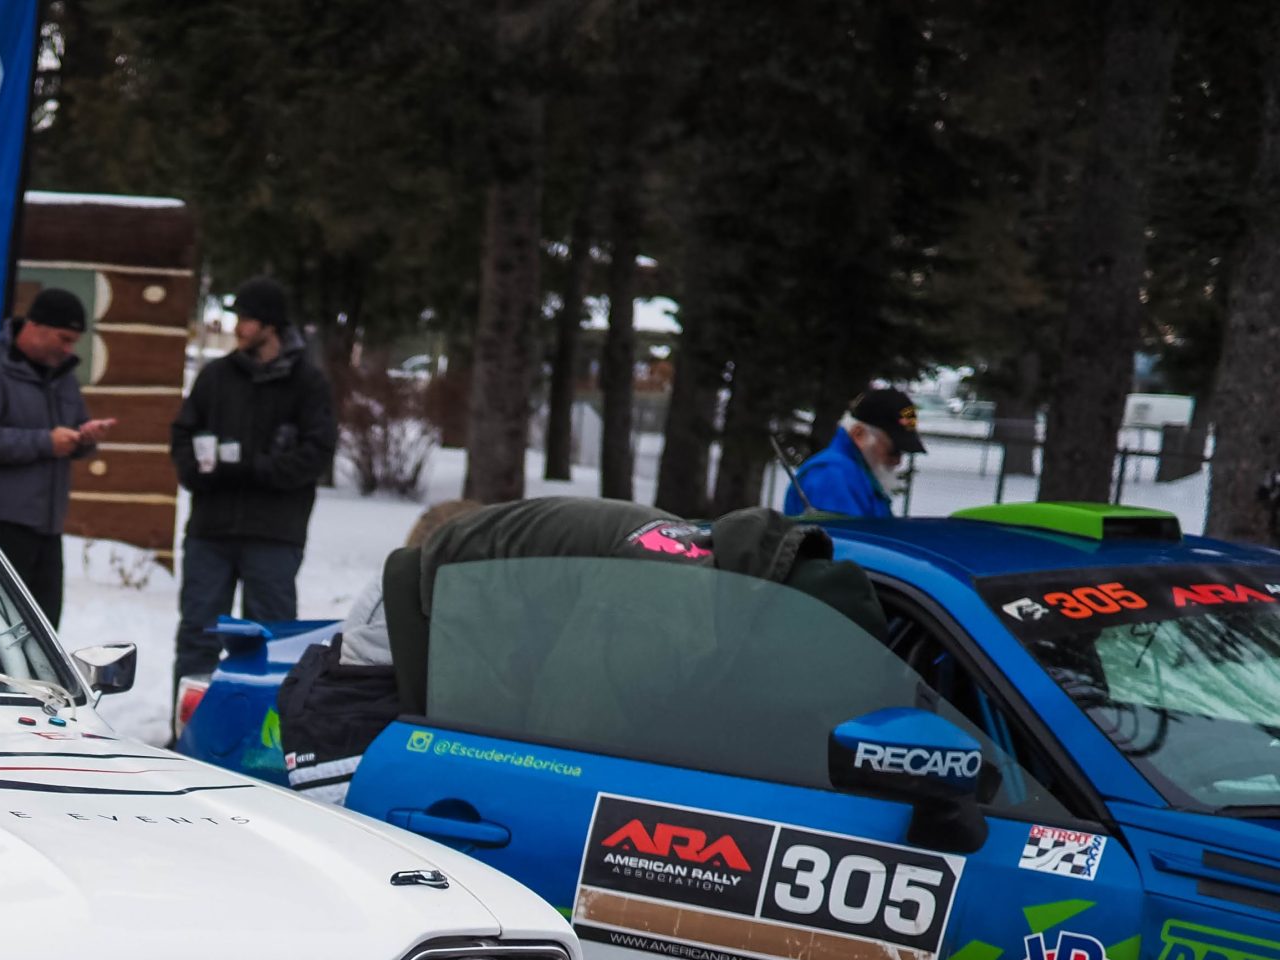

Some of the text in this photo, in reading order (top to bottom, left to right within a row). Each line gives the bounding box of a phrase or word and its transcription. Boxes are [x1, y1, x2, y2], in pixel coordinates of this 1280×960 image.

[1043, 582, 1148, 620] 305
[1172, 583, 1276, 607] ARA
[433, 739, 583, 777] @EscuderiaBoricua
[853, 741, 983, 778] RECARO
[66, 811, 251, 826] EVENTS
[1030, 825, 1092, 843] DETROIT
[601, 818, 752, 872] ARA
[604, 853, 742, 887] AMERICAN RALLY
[612, 865, 725, 893] ASSOCIATION
[773, 844, 945, 937] 305
